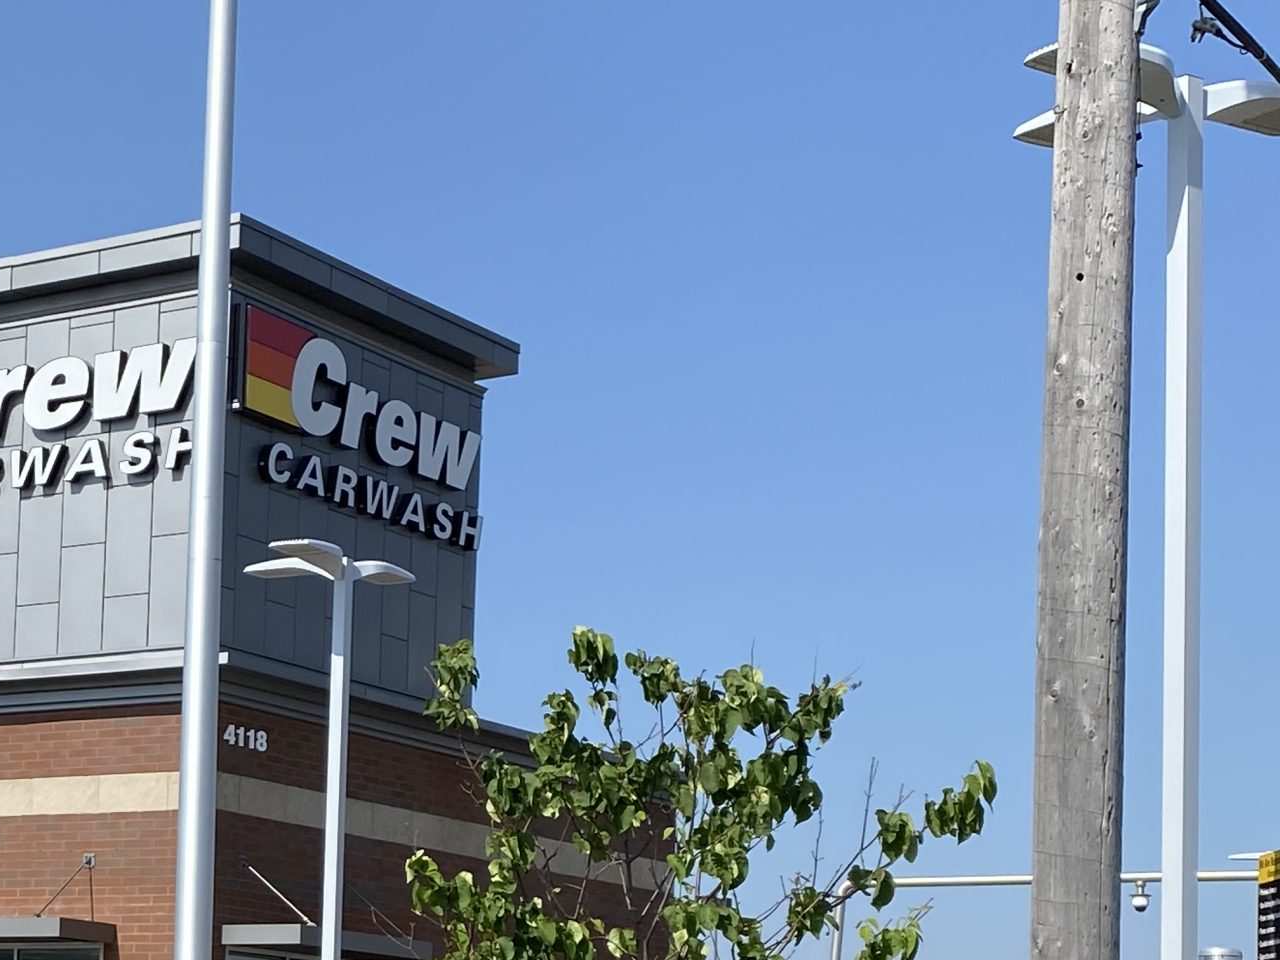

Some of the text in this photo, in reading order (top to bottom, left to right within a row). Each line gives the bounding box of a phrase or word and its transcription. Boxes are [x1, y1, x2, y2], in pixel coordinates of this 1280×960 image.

[291, 337, 482, 492] Crew
[267, 442, 484, 551] CARWASH
[223, 724, 268, 752] 4118
